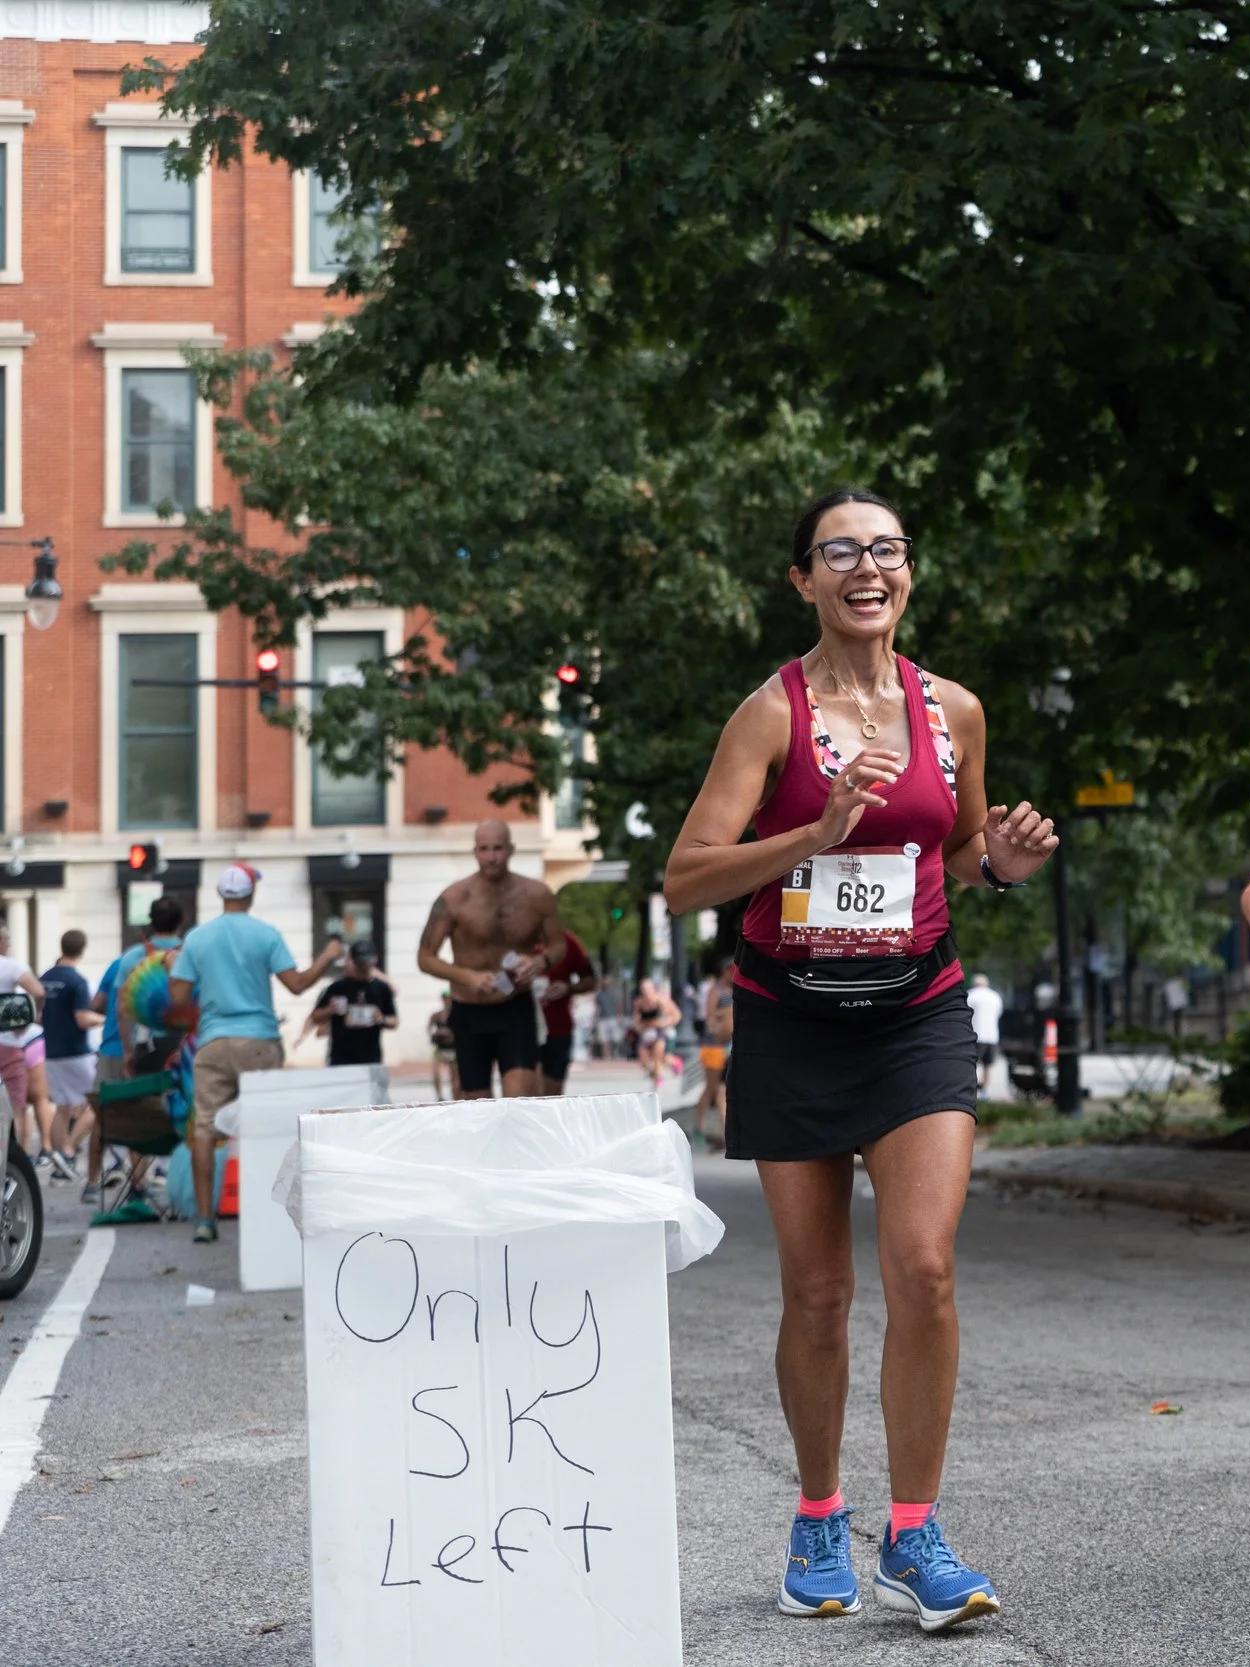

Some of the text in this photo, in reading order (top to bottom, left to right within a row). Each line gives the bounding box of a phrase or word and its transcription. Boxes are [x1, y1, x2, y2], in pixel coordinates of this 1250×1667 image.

[792, 869, 803, 888] B
[837, 882, 885, 912] 682
[335, 1231, 600, 1399] Only
[381, 1500, 613, 1587] Left
